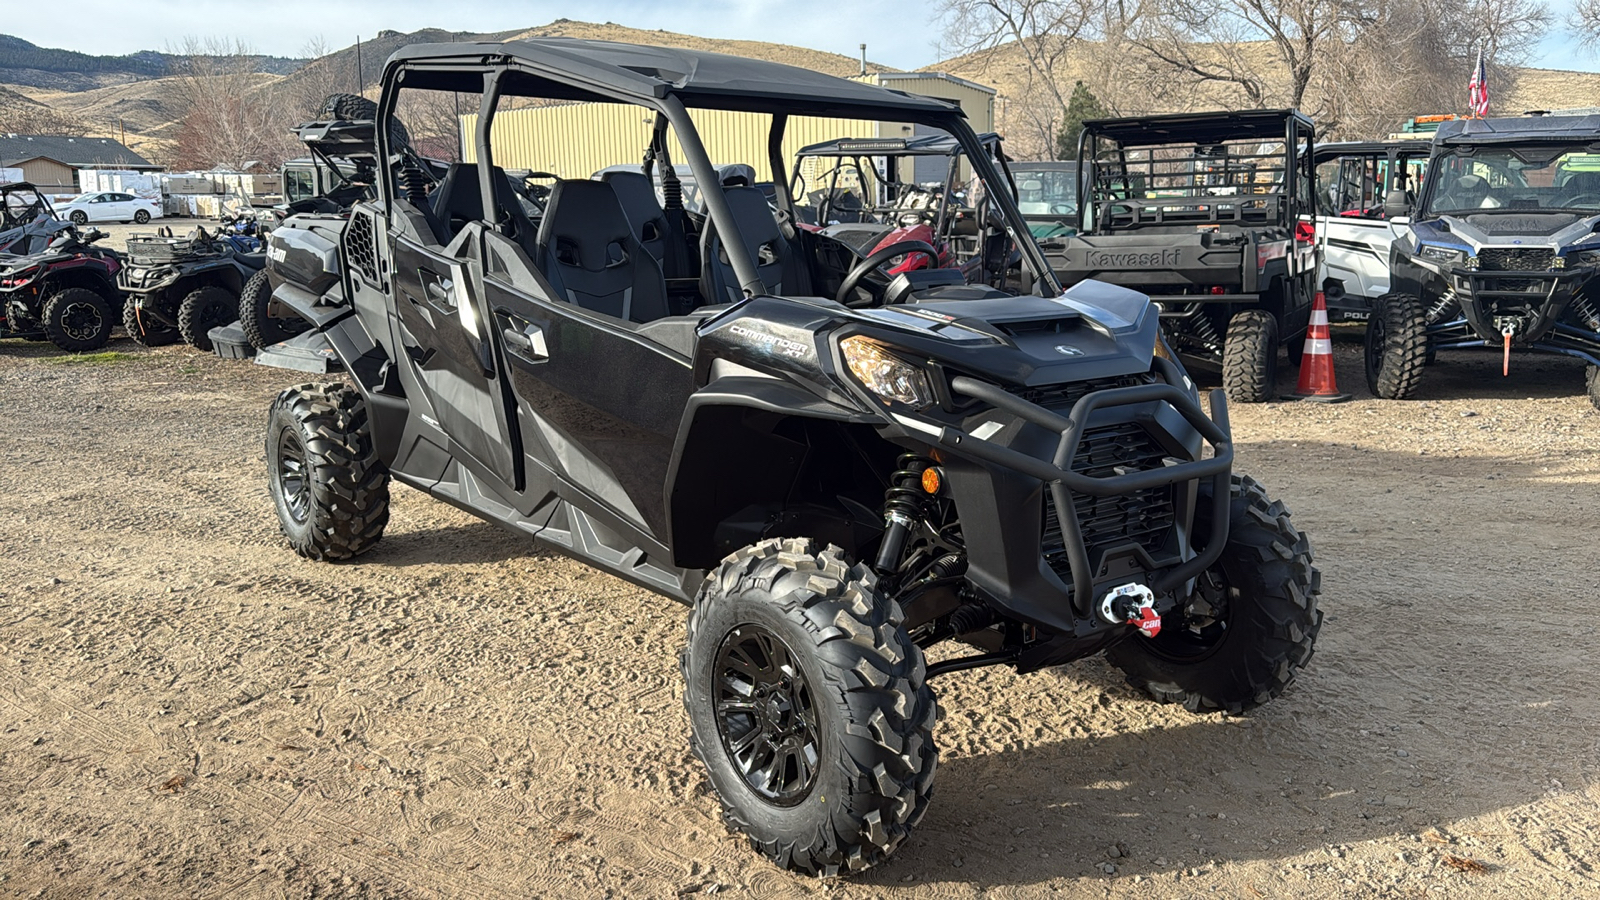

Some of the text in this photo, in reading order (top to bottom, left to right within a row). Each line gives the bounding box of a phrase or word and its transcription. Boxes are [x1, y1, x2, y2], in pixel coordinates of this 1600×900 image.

[1572, 232, 1596, 245] 1000
[1085, 249, 1180, 267] Kawasaki
[729, 325, 808, 352] COMMANDER
[782, 348, 804, 358] XT
